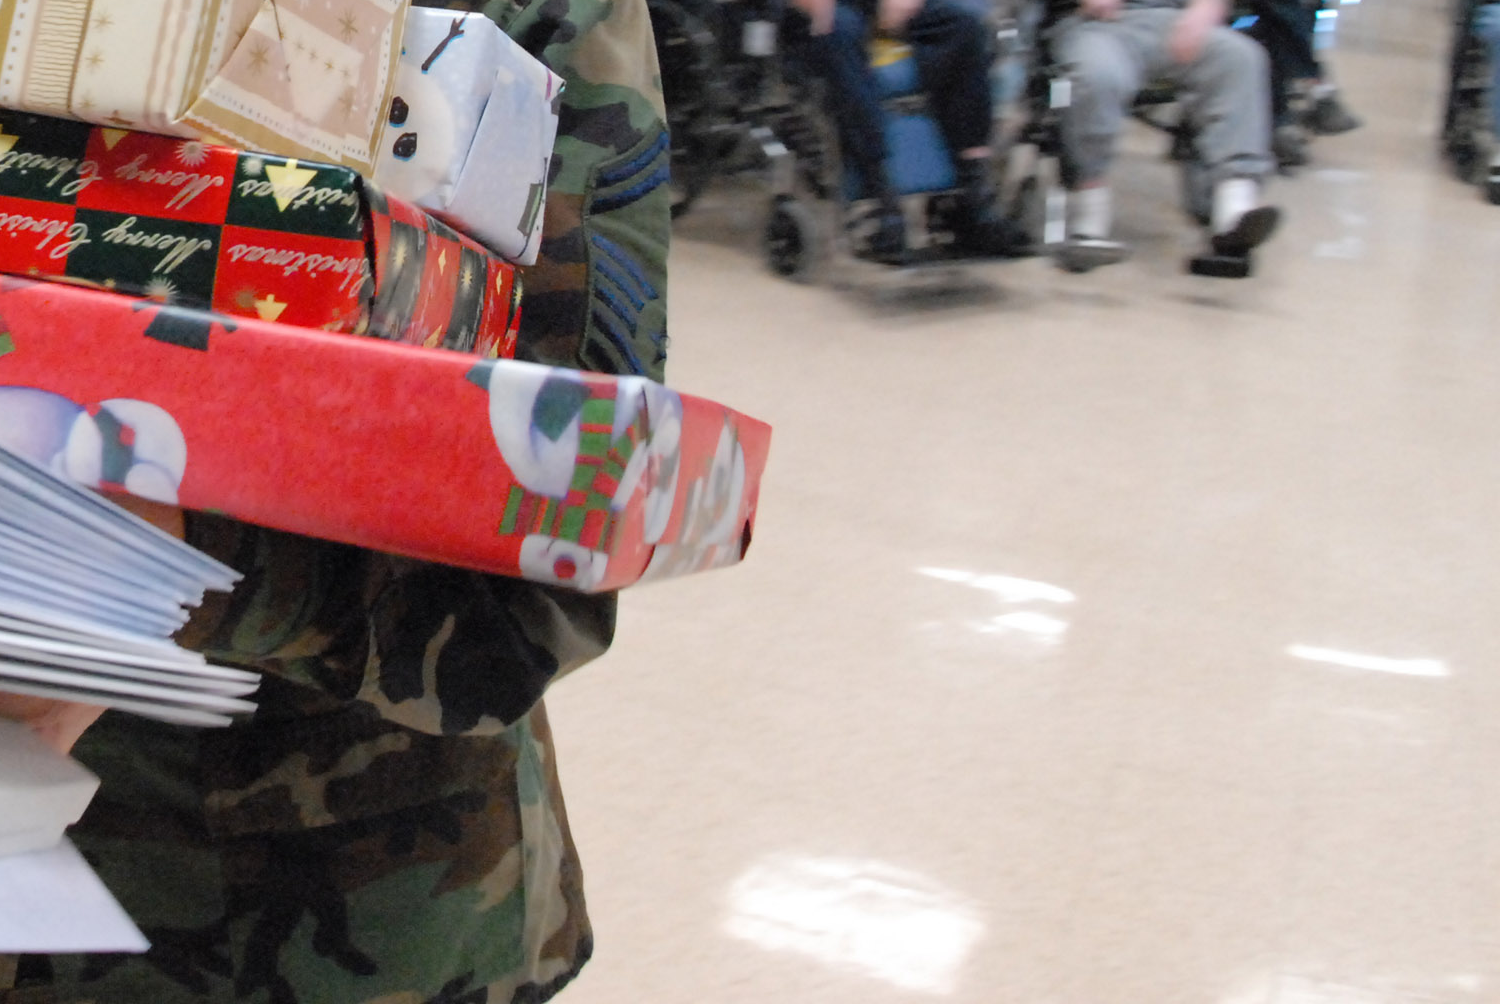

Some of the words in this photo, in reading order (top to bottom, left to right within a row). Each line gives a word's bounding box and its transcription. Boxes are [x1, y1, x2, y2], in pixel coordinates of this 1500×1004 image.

[115, 154, 224, 210] Merry
[237, 179, 363, 232] hristmas
[102, 216, 212, 274] Merry
